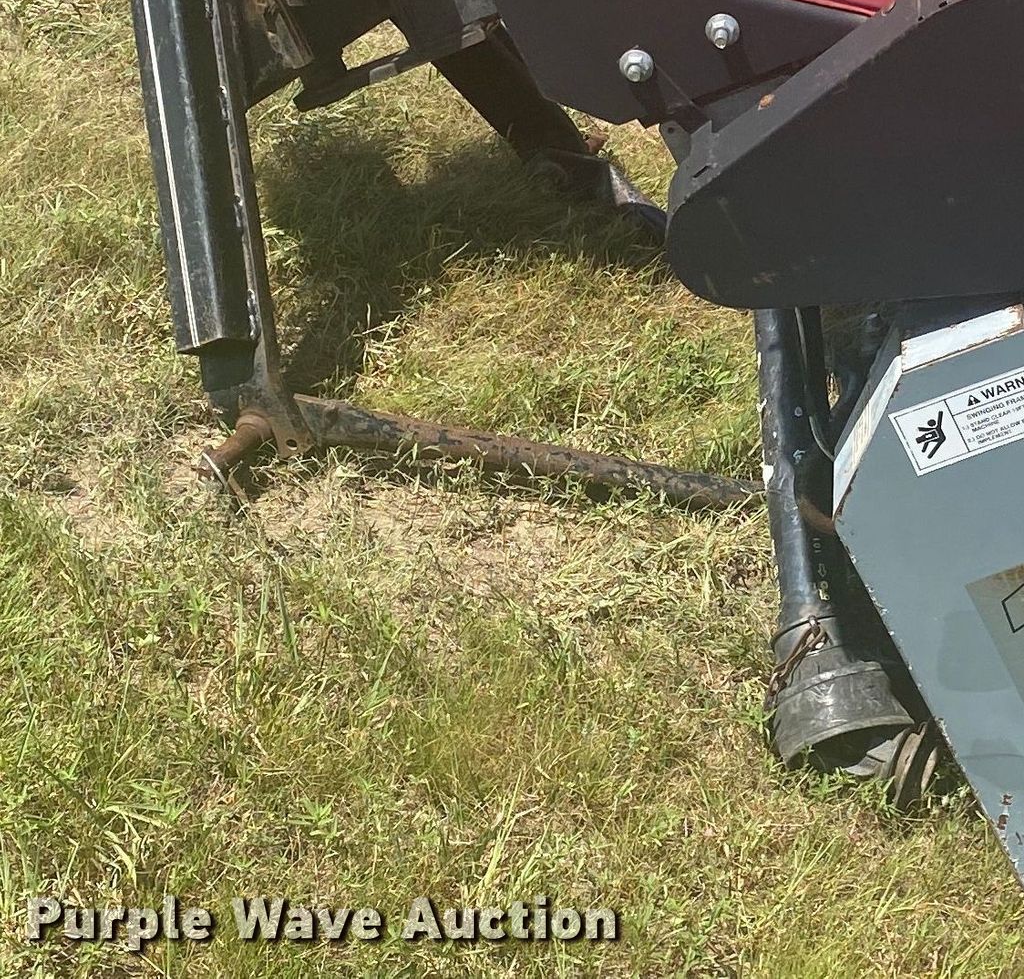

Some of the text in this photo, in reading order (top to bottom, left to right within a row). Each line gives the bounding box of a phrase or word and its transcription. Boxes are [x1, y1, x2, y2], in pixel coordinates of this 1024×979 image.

[966, 399, 1005, 420] SWINGING
[970, 417, 991, 429] STAND
[991, 410, 1011, 421] CLEAR
[1000, 420, 1021, 432] ALLOW
